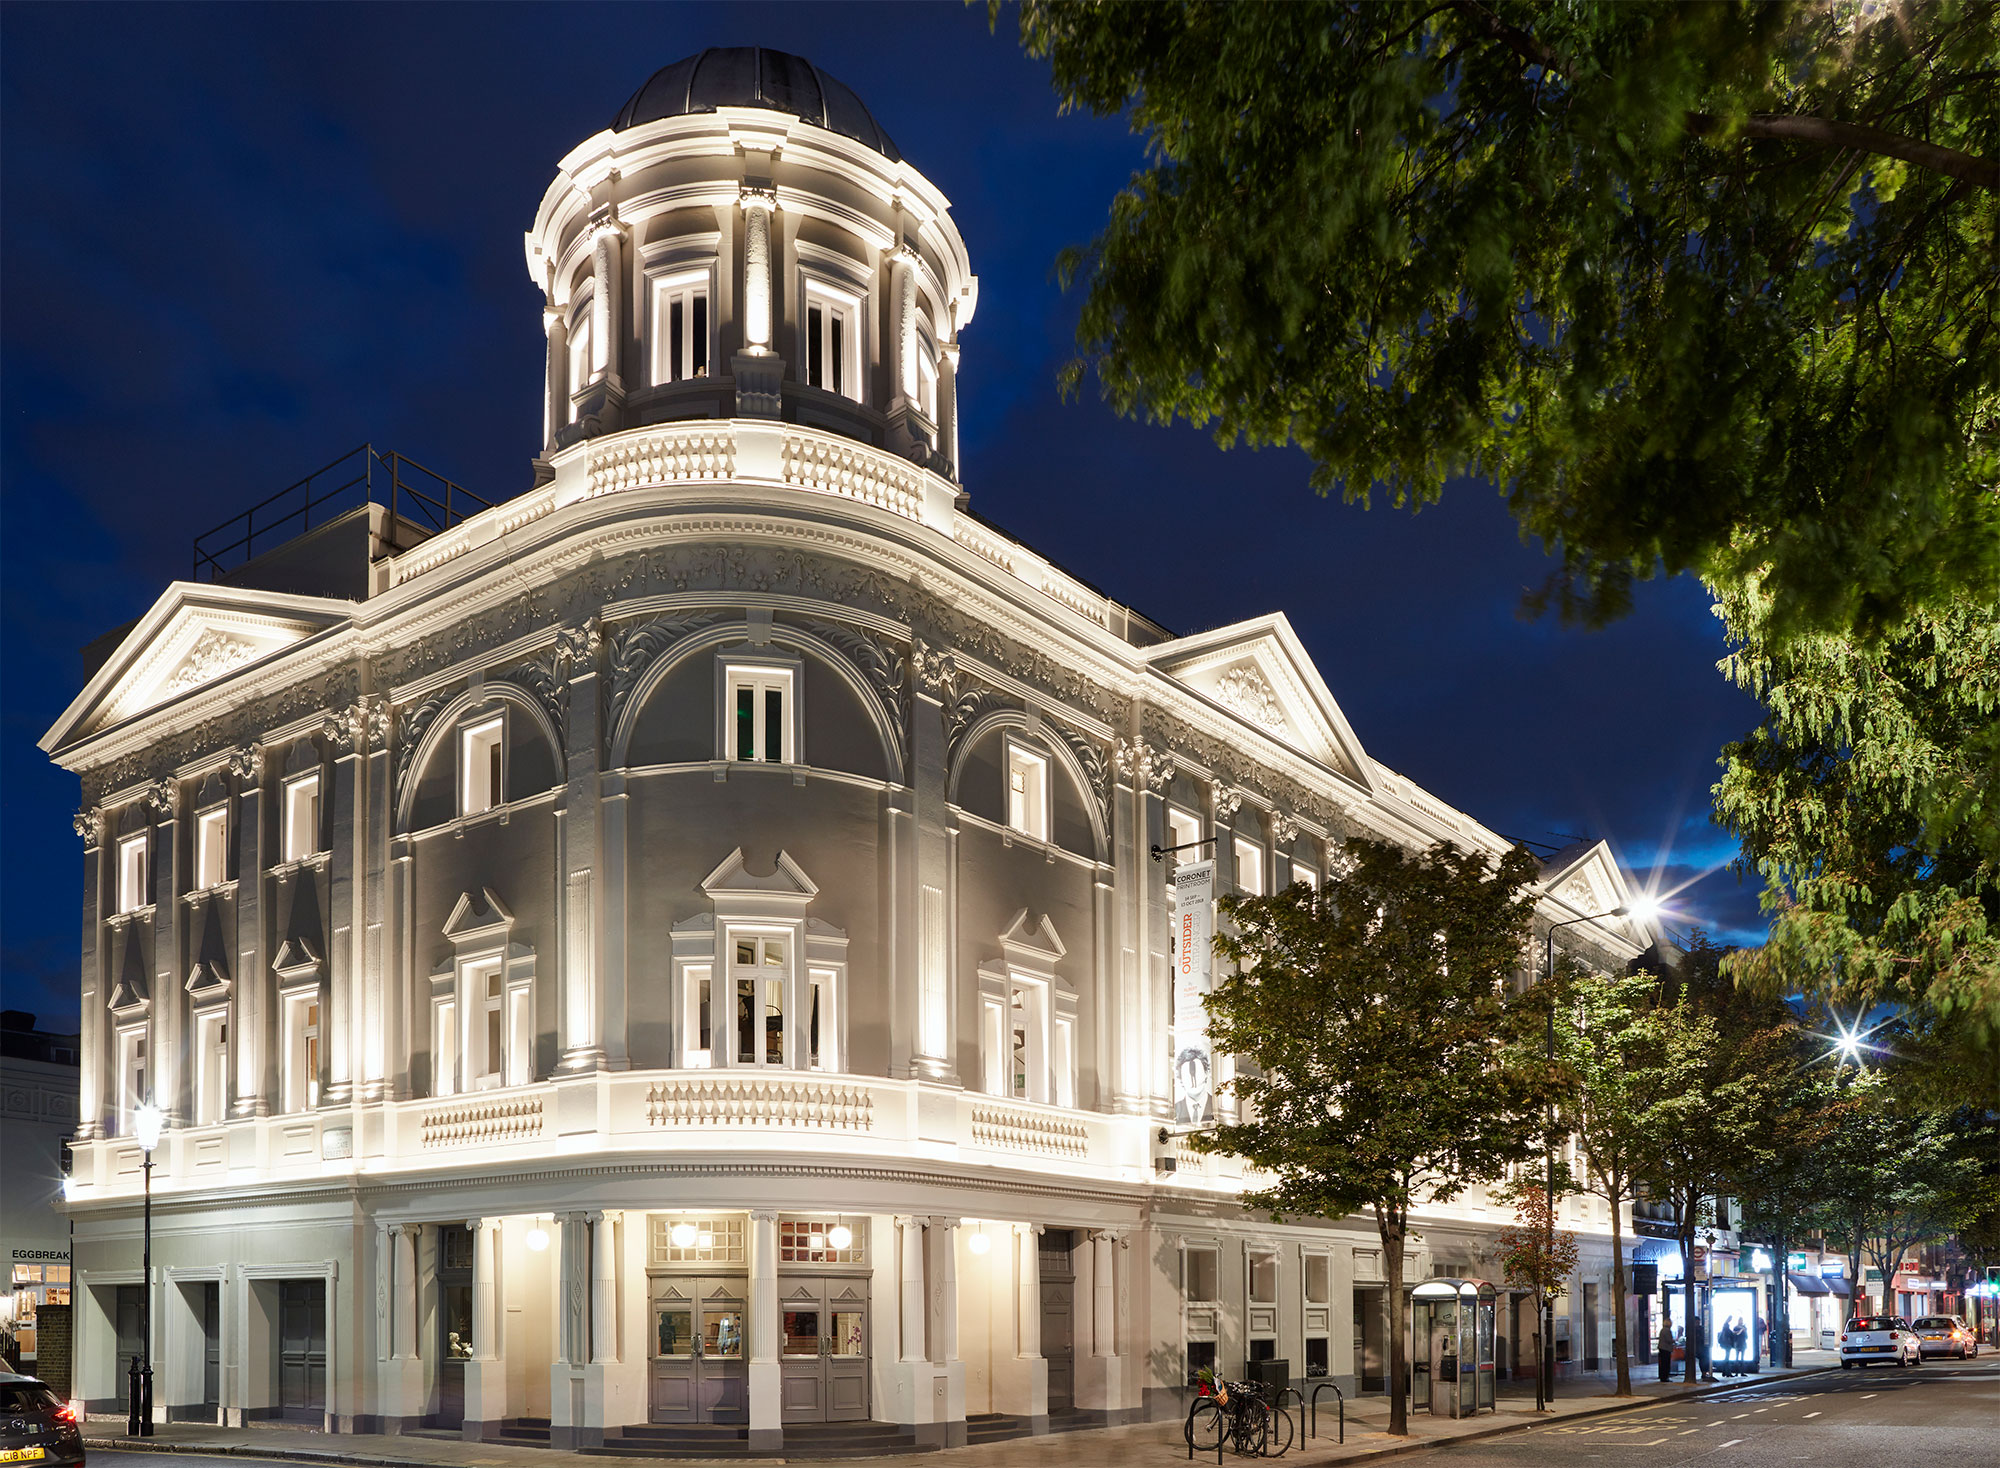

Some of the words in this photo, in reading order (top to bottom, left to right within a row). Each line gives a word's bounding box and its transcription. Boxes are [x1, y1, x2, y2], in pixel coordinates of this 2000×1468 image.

[1177, 869, 1211, 883] CORONET
[1177, 879, 1211, 890] PRINTROOM
[1182, 913, 1192, 974] OUTSIDER
[12, 1249, 70, 1260] EGGBREAK
[1543, 1425, 1678, 1435] STOP
[20, 1449, 38, 1459] NPF
